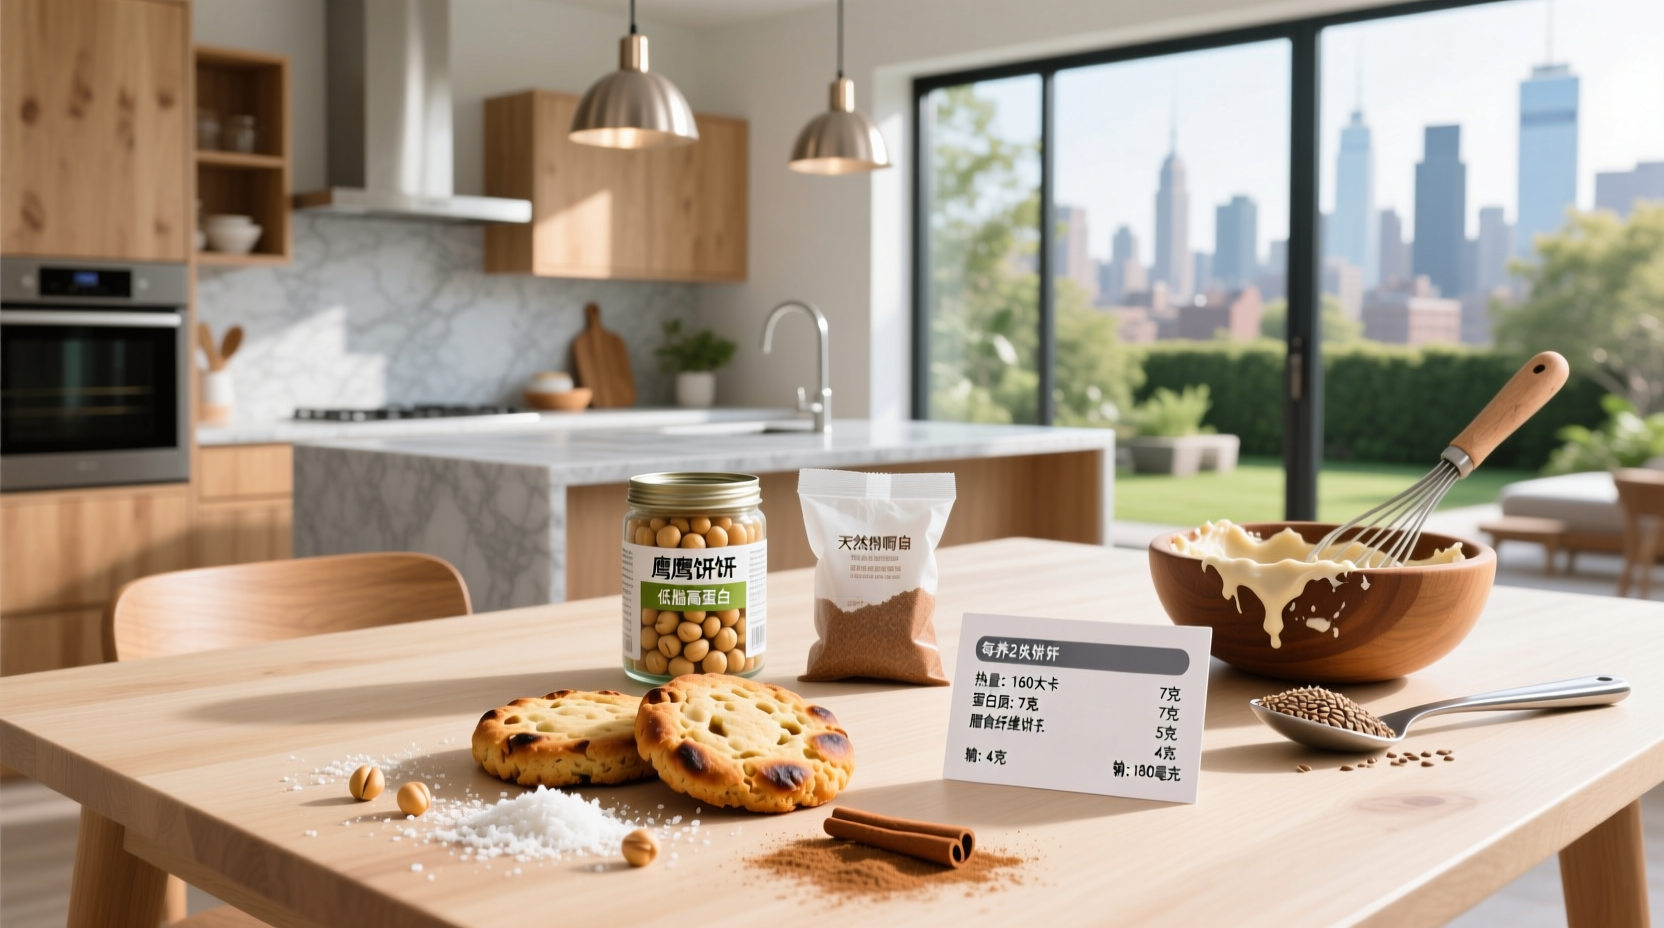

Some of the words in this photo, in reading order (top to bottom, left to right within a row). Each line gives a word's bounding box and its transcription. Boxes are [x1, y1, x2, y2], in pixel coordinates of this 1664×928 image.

[1160, 686, 1181, 702] 7克
[1158, 705, 1180, 721] 7克
[1155, 724, 1177, 741] 5克
